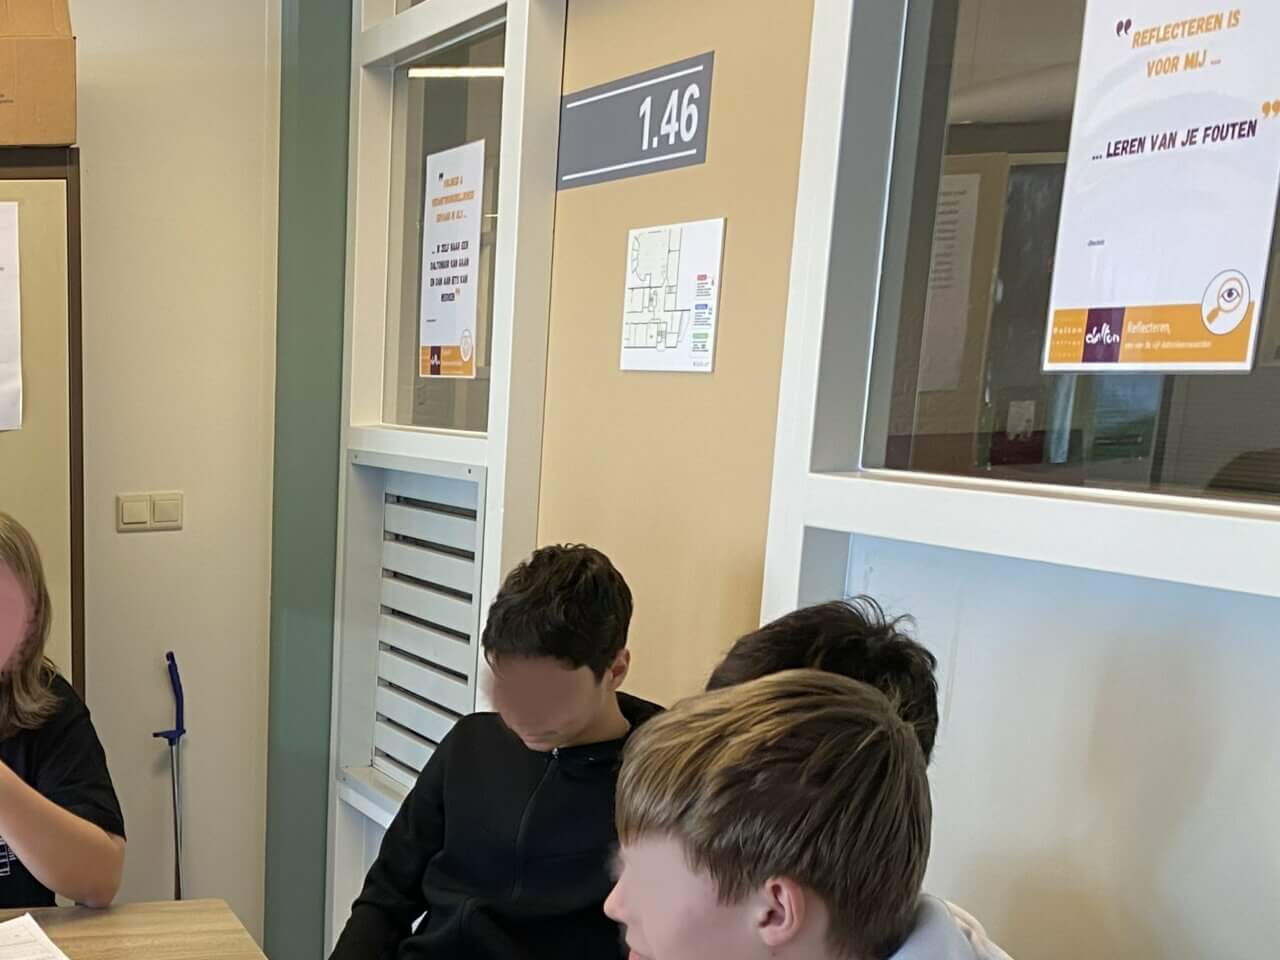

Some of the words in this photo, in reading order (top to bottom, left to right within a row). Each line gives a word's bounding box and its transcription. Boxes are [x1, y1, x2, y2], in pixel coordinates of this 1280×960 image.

[1132, 13, 1222, 49] REFLECTEREN
[1227, 10, 1240, 28] IS
[1147, 55, 1179, 78] VOOR
[1183, 50, 1207, 71] MIJ
[639, 83, 700, 150] 1.46
[1105, 135, 1146, 158] LEREN
[1150, 128, 1176, 151] VAN
[1181, 126, 1198, 147] JE
[1201, 119, 1258, 143] FOUTEN
